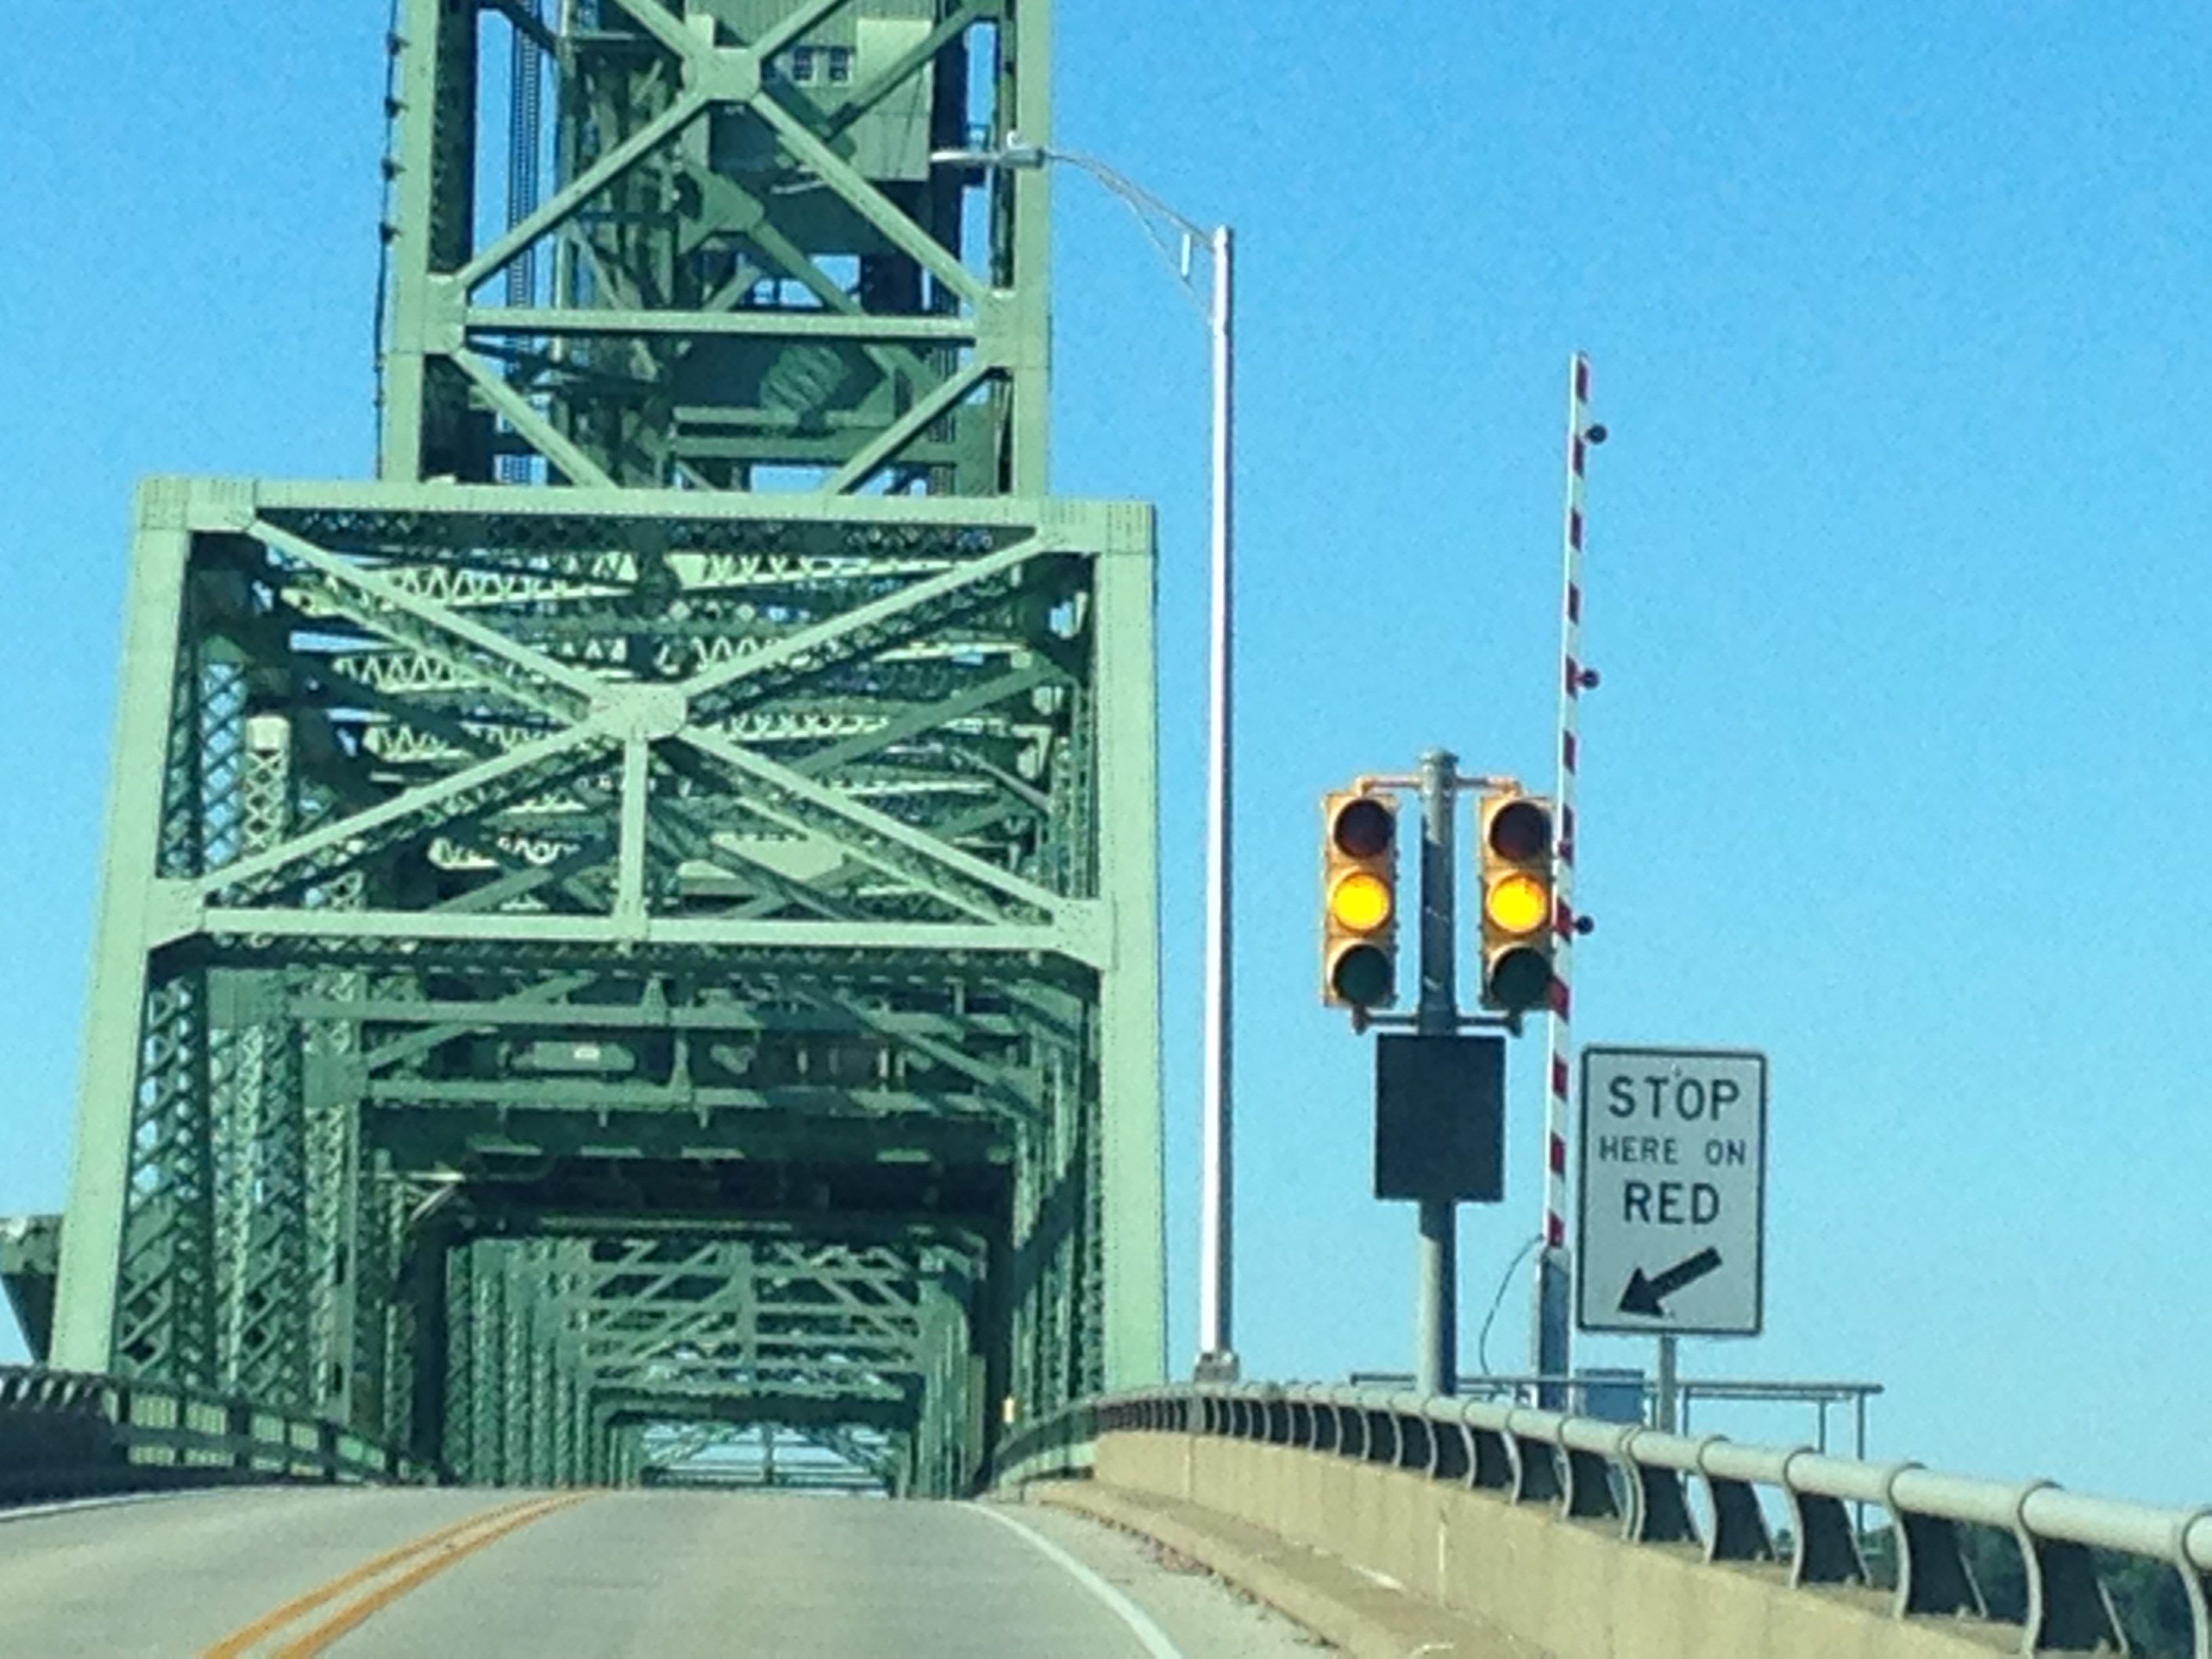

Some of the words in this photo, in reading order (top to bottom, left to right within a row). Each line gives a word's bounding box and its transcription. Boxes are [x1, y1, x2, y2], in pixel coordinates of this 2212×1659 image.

[1608, 1075, 1740, 1120] STOP
[1599, 1136, 1679, 1165] HERE
[1704, 1139, 1746, 1166] ON
[1624, 1181, 1720, 1225] RED
